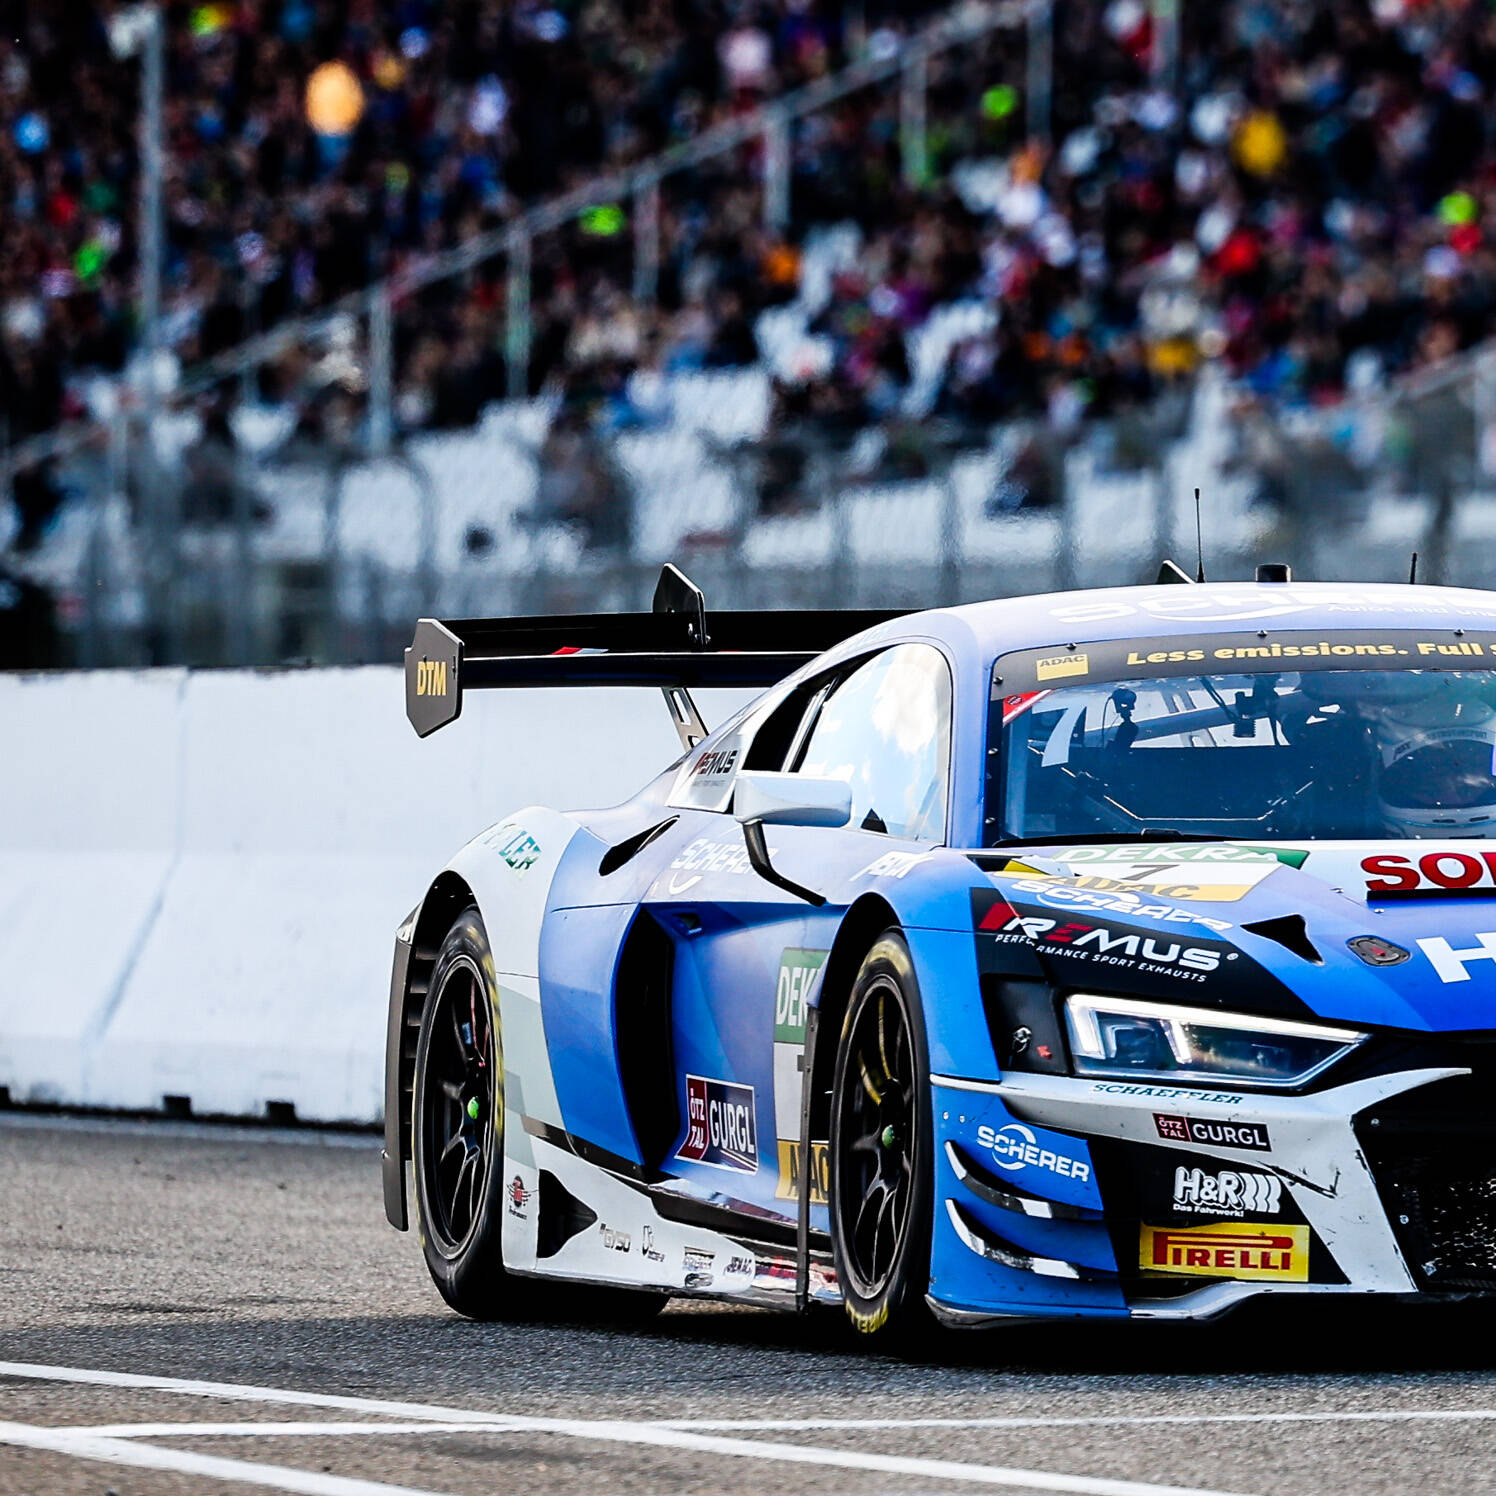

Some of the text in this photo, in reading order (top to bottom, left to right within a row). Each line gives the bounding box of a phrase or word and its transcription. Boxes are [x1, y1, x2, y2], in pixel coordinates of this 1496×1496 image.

[1039, 654, 1085, 668] ADAC
[1126, 649, 1205, 666] Less
[1214, 642, 1409, 660] emissions.
[1416, 642, 1484, 656] Full
[416, 661, 447, 696] DTM
[1031, 702, 1088, 768] 7
[1054, 846, 1280, 863] DEKRA
[1041, 876, 1200, 899] ADAC
[1122, 864, 1181, 881] 7
[1011, 879, 1235, 932] SCHERER
[1002, 916, 1222, 972] REMUS
[1091, 953, 1135, 969] SPORT
[1137, 962, 1208, 984] EXHAUSTS
[775, 966, 820, 1027] DEK
[689, 1087, 706, 1121] ÖTZ
[1093, 1084, 1244, 1105] SCHAEFFLER
[688, 1125, 706, 1150] TAL
[708, 1099, 756, 1154] GURGL
[1160, 1127, 1186, 1138] TAL
[1192, 1123, 1267, 1147] GURGL
[976, 1124, 1091, 1183] SCHERER
[1173, 1165, 1245, 1210] H&R
[1152, 1231, 1295, 1271] PIRELLI
